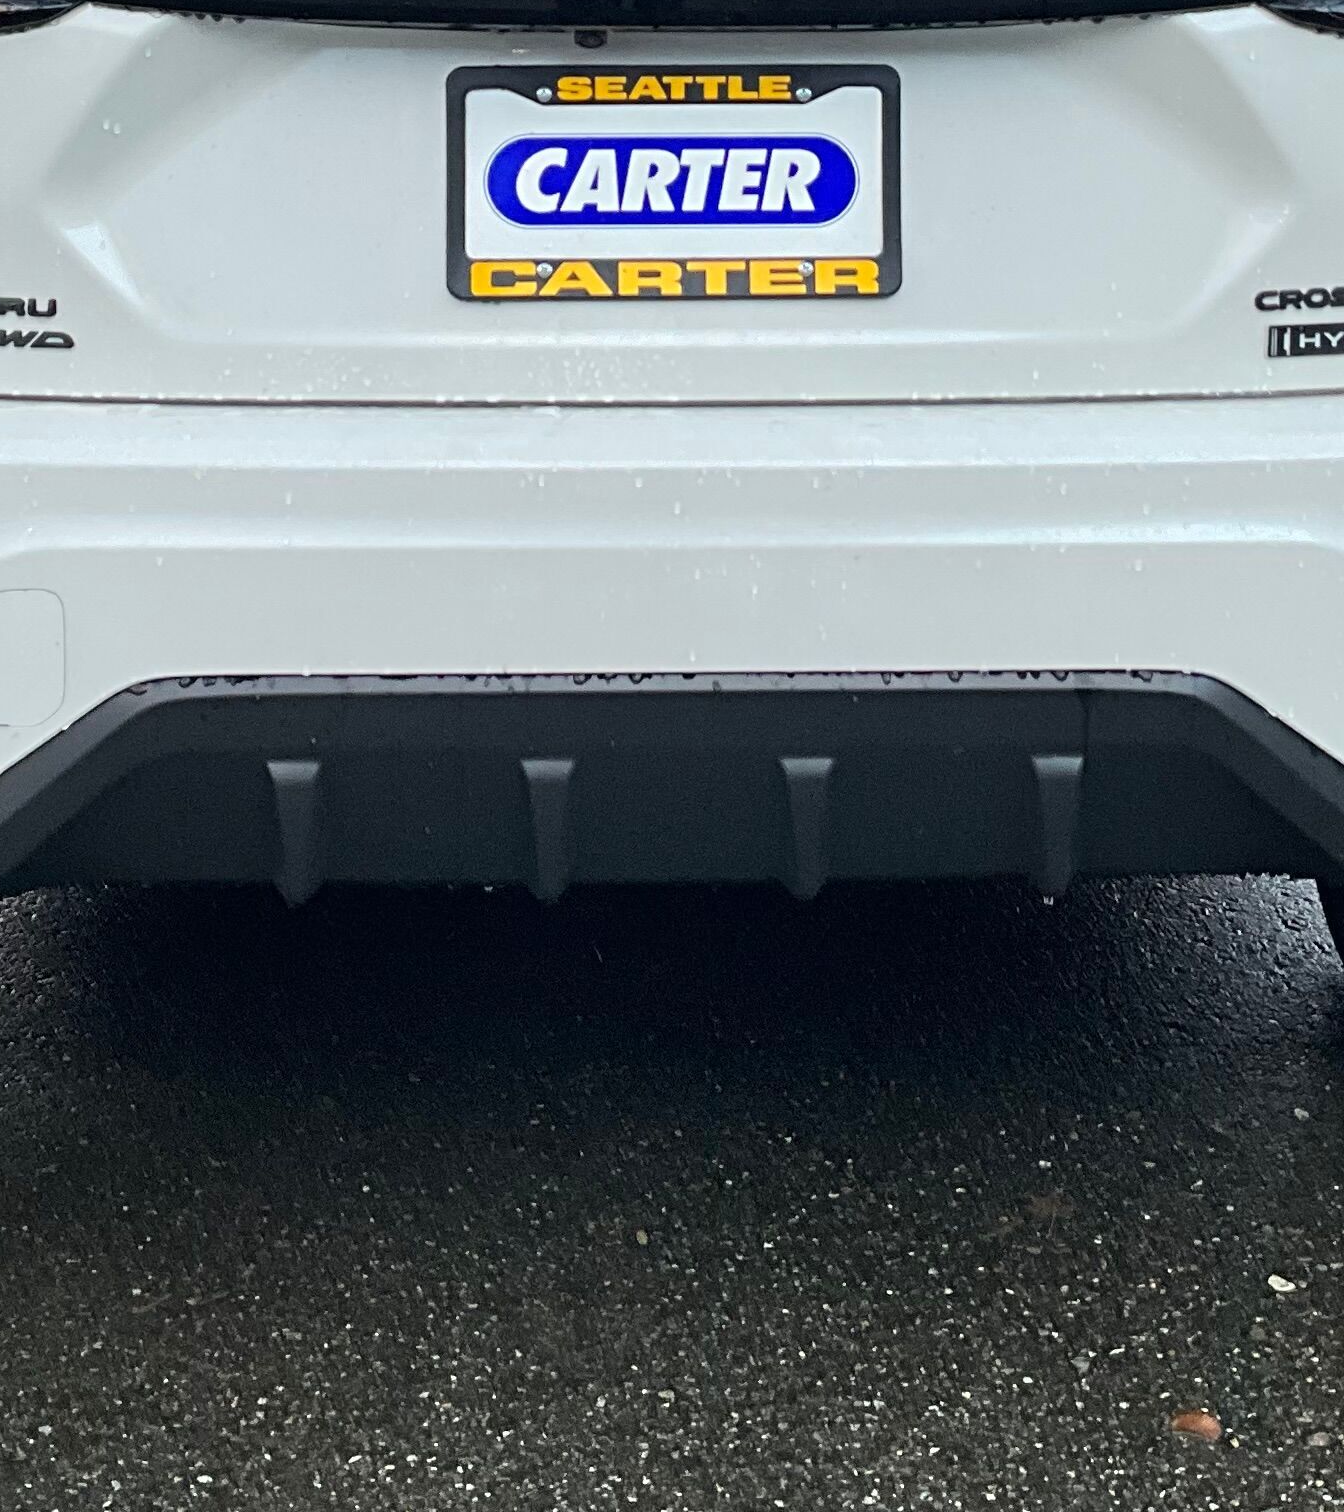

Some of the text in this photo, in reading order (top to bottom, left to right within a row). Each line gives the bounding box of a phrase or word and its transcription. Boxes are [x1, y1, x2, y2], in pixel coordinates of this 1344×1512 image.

[556, 75, 792, 101] SEATTLE
[515, 147, 821, 214] CARTER
[470, 259, 880, 297] CARTER
